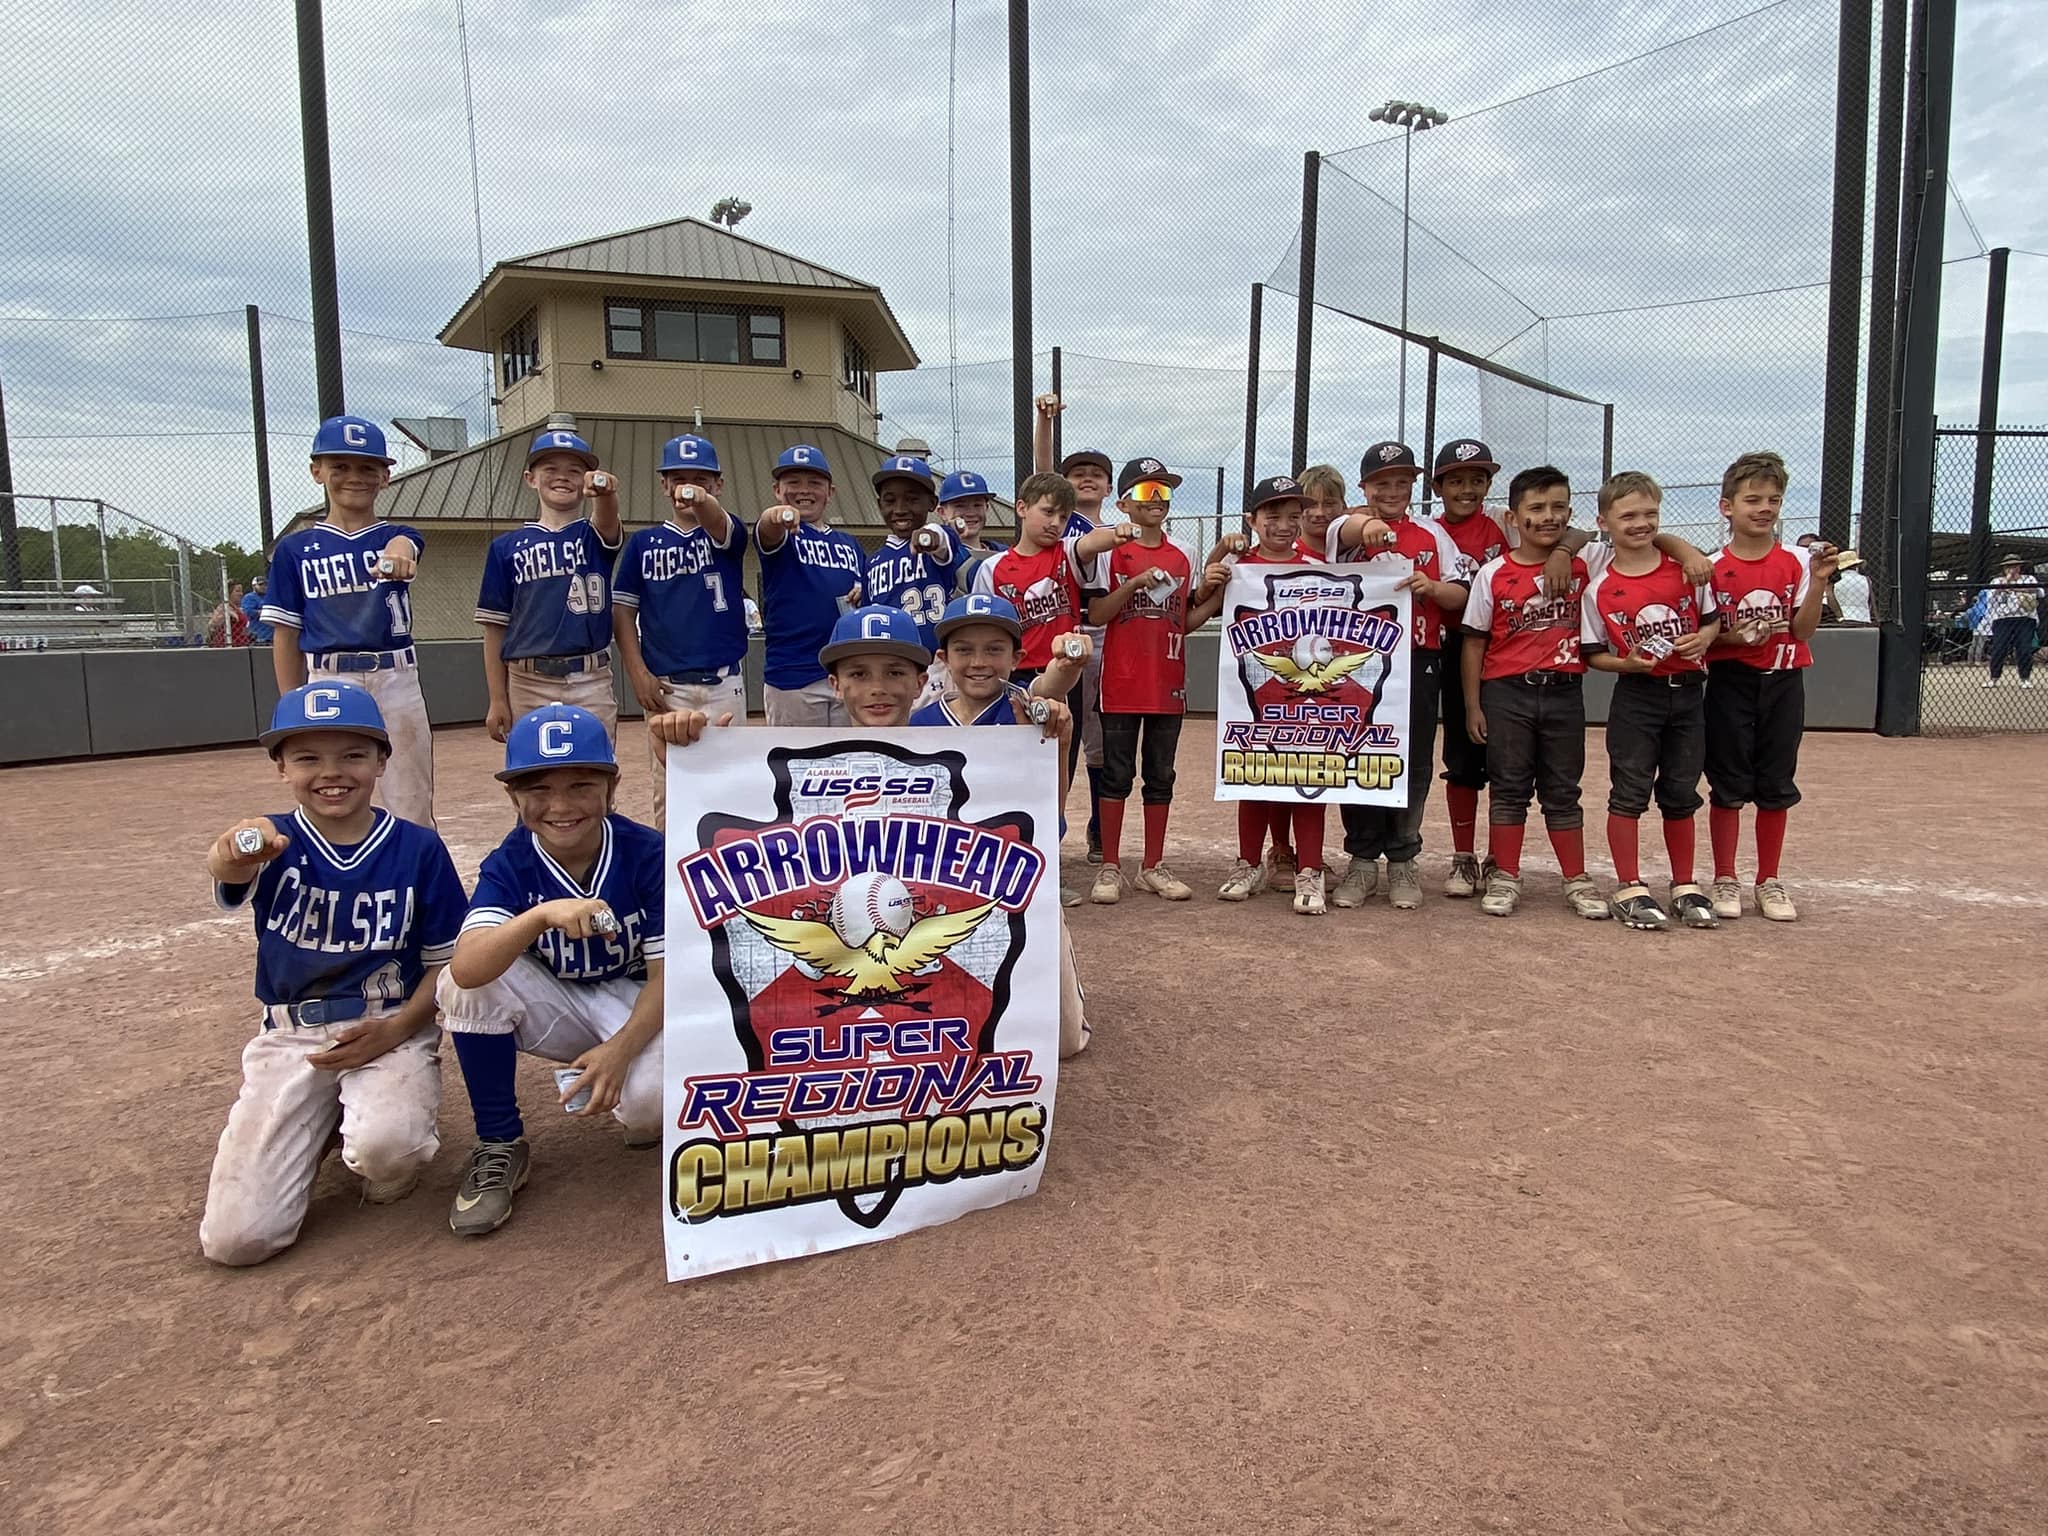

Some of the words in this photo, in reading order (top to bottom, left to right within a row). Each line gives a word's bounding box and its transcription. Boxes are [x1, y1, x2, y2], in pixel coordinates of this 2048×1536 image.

[343, 423, 367, 447] C
[552, 431, 574, 449] C
[679, 440, 698, 460] C
[793, 448, 811, 464] C
[895, 456, 914, 472] C
[960, 472, 976, 489] C
[795, 535, 861, 577] CHELSE
[566, 573, 605, 615] 99
[703, 572, 728, 612] 7
[901, 584, 945, 626] 23
[966, 595, 992, 616] C
[861, 614, 891, 640] C
[1229, 608, 1402, 655] ARROWHEAD
[1167, 631, 1183, 660] 17
[1772, 643, 1797, 669] 17
[304, 689, 341, 720] C
[1263, 705, 1361, 723] SUPER
[538, 720, 575, 758] C
[1225, 723, 1399, 750] REGIONAL
[806, 769, 848, 777] ALABAMA
[1223, 752, 1403, 789] RUNNER-UP
[683, 820, 1039, 921] ARROWHEAD
[266, 866, 415, 952] CHELSEA
[769, 1019, 972, 1066] SUPER
[685, 1056, 1037, 1134] REGIONAL
[675, 1107, 1042, 1214] CHAMPIONS
